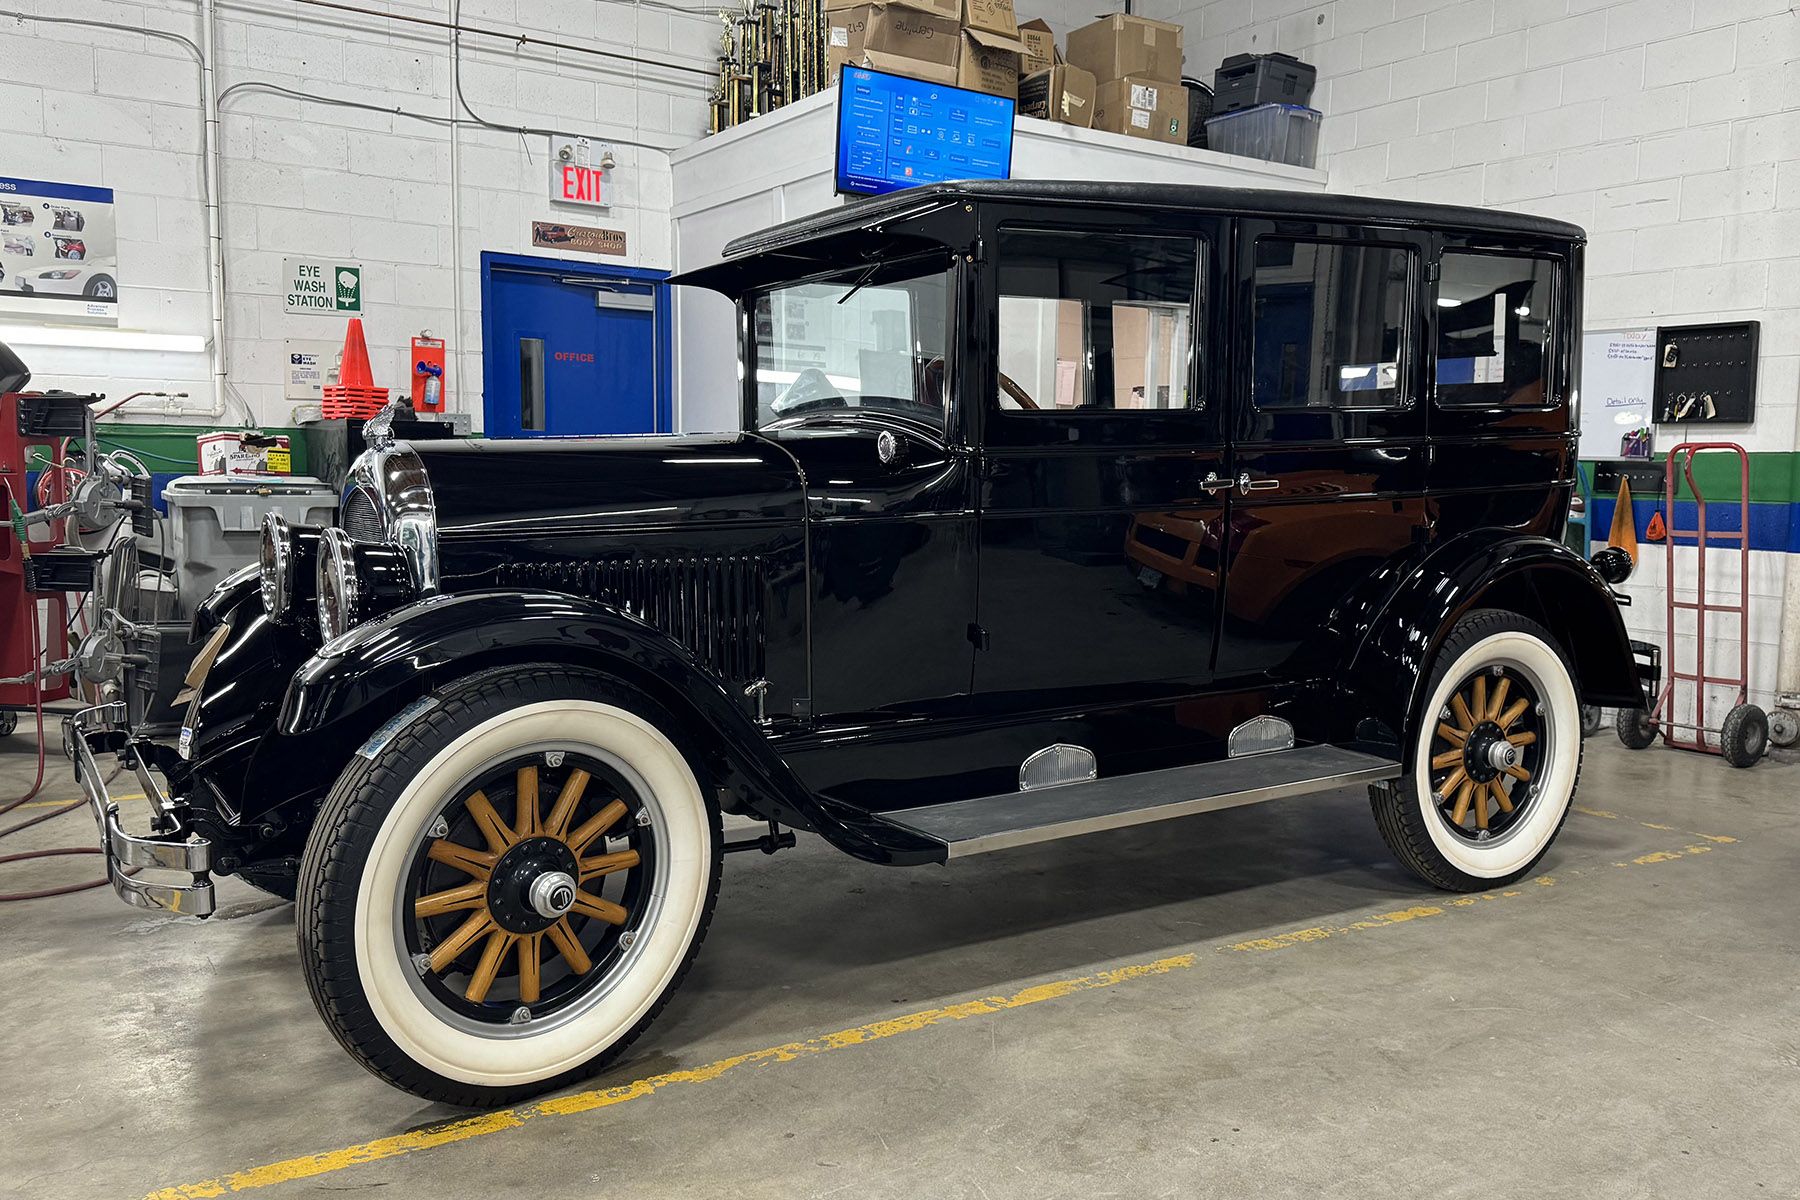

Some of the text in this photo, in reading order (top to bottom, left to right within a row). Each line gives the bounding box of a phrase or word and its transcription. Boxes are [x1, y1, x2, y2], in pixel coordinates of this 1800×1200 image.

[563, 166, 603, 202] EXIT
[603, 230, 626, 243] Bros.
[570, 238, 623, 249] BODY SHOP
[299, 265, 320, 278] EYE
[294, 280, 325, 293] WASH
[287, 294, 333, 308] STATION
[554, 352, 594, 362] OFFICE
